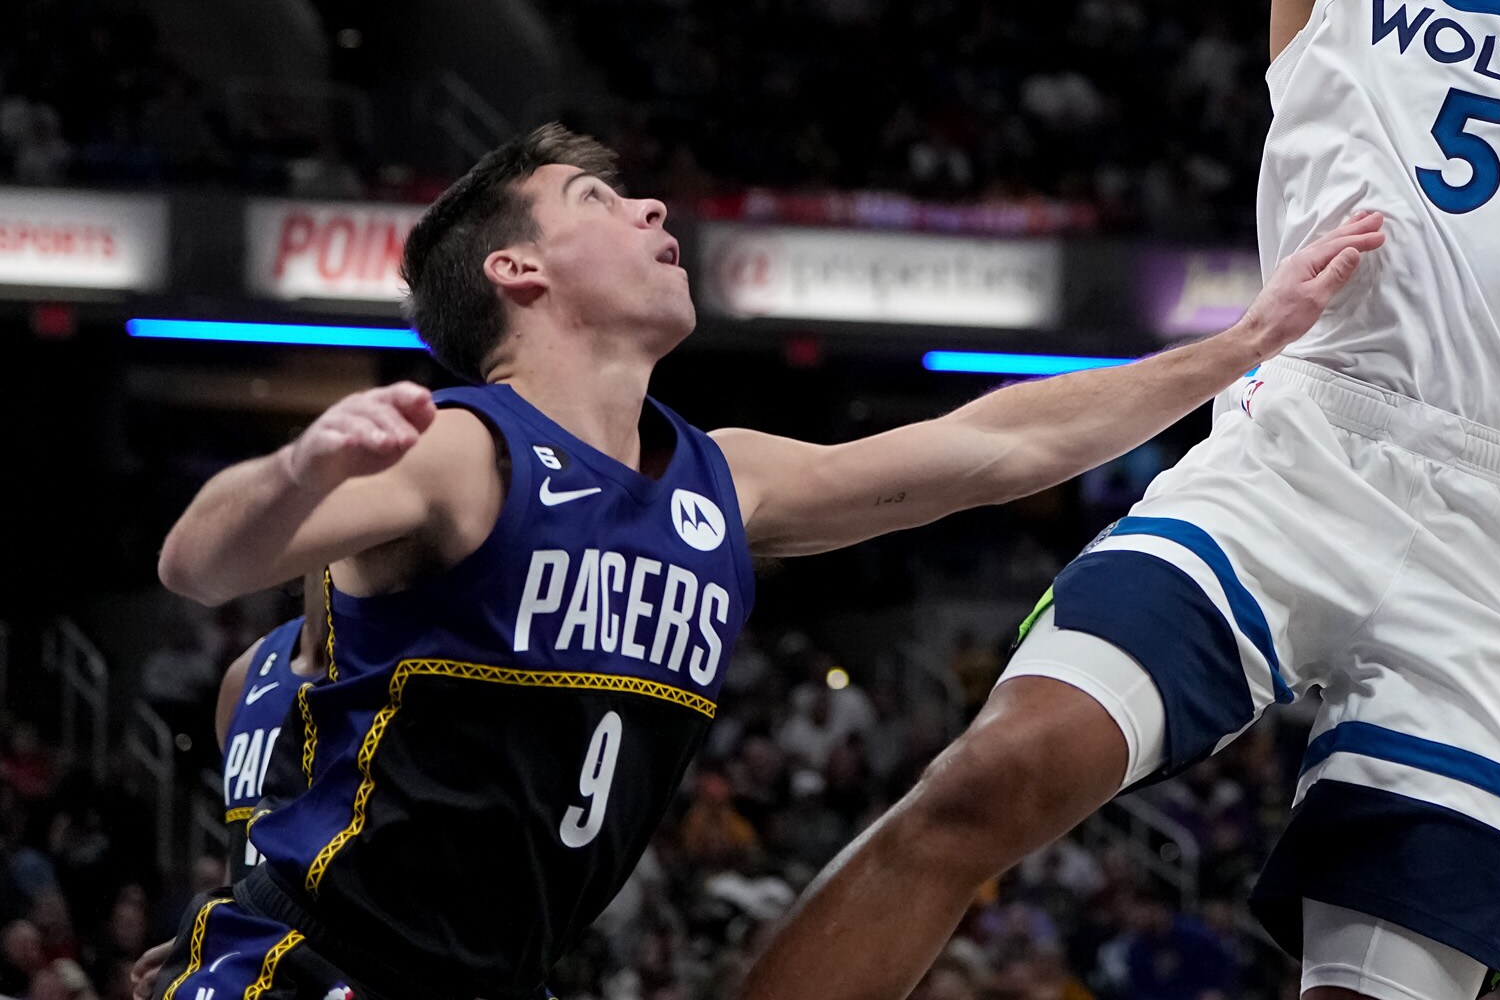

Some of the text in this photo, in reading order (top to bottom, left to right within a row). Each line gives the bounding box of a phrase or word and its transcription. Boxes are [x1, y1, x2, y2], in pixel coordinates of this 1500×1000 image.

[533, 444, 565, 471] 6
[513, 548, 729, 687] PACERS
[559, 710, 624, 849] 9
